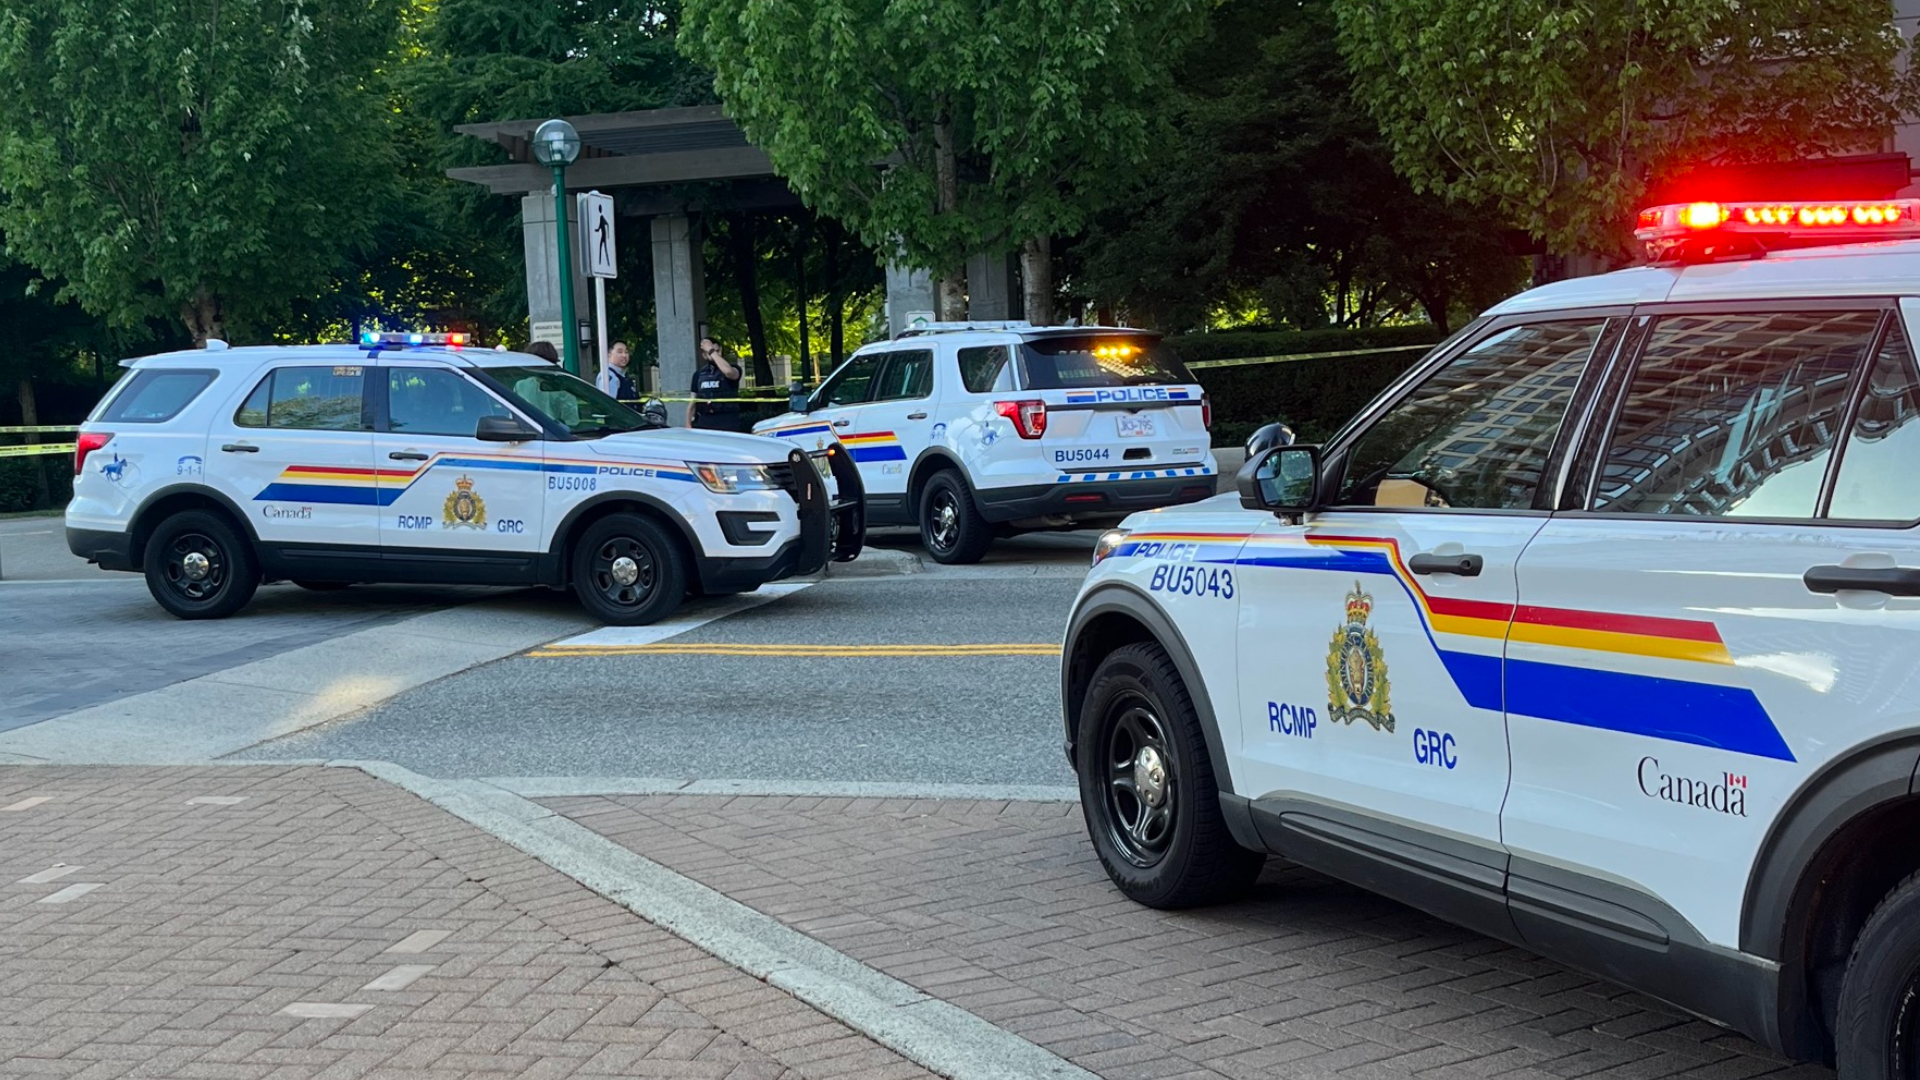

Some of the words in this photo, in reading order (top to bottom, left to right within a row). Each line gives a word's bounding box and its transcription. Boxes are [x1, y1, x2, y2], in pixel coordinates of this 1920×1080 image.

[1096, 388, 1168, 402] POLICE
[1055, 448, 1110, 462] BU5044
[177, 465, 202, 476] 9-1-1
[598, 466, 655, 478] POLICE
[548, 476, 597, 491] BU5008
[262, 504, 312, 519] Canada
[398, 515, 433, 529] RCMP
[497, 519, 524, 533] GRC
[1133, 542, 1197, 561] POLICE
[1150, 564, 1234, 599] BU5043
[1268, 701, 1317, 739] RCMP
[1413, 728, 1457, 770] GRC
[1637, 756, 1749, 818] Canada
